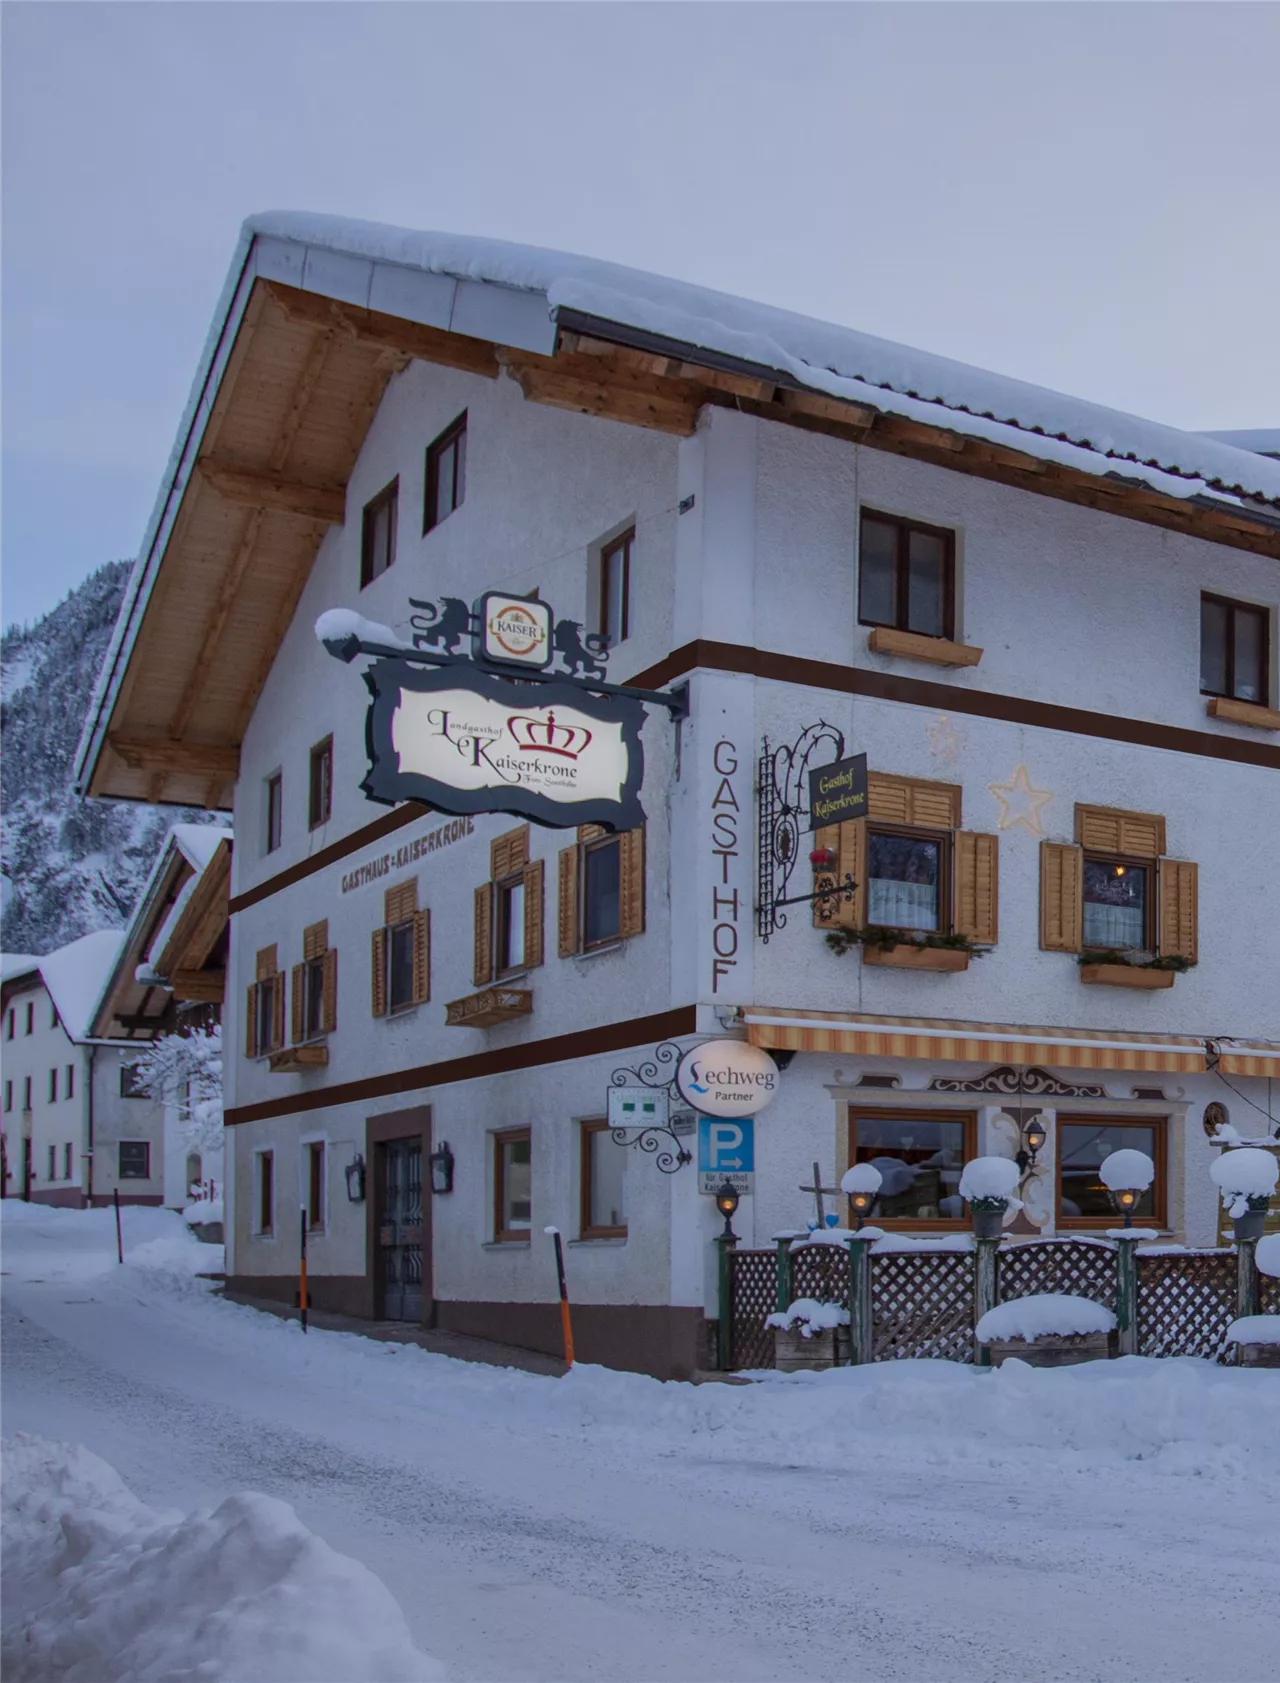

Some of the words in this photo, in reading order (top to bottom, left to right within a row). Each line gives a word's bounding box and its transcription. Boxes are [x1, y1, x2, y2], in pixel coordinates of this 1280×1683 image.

[497, 620, 537, 638] KAISER
[427, 709, 504, 746] Landgasthof
[457, 735, 578, 783] Kaiserkrone
[819, 767, 855, 794] Gasthof
[812, 792, 865, 819] Kaiserkrone
[341, 853, 390, 894] GASTHAUS
[397, 815, 475, 869] KAISERKRONE
[711, 740, 740, 994] GASTHOF
[688, 1060, 775, 1094] Lechweg
[715, 1091, 754, 1102] Partner
[709, 1123, 744, 1169] P
